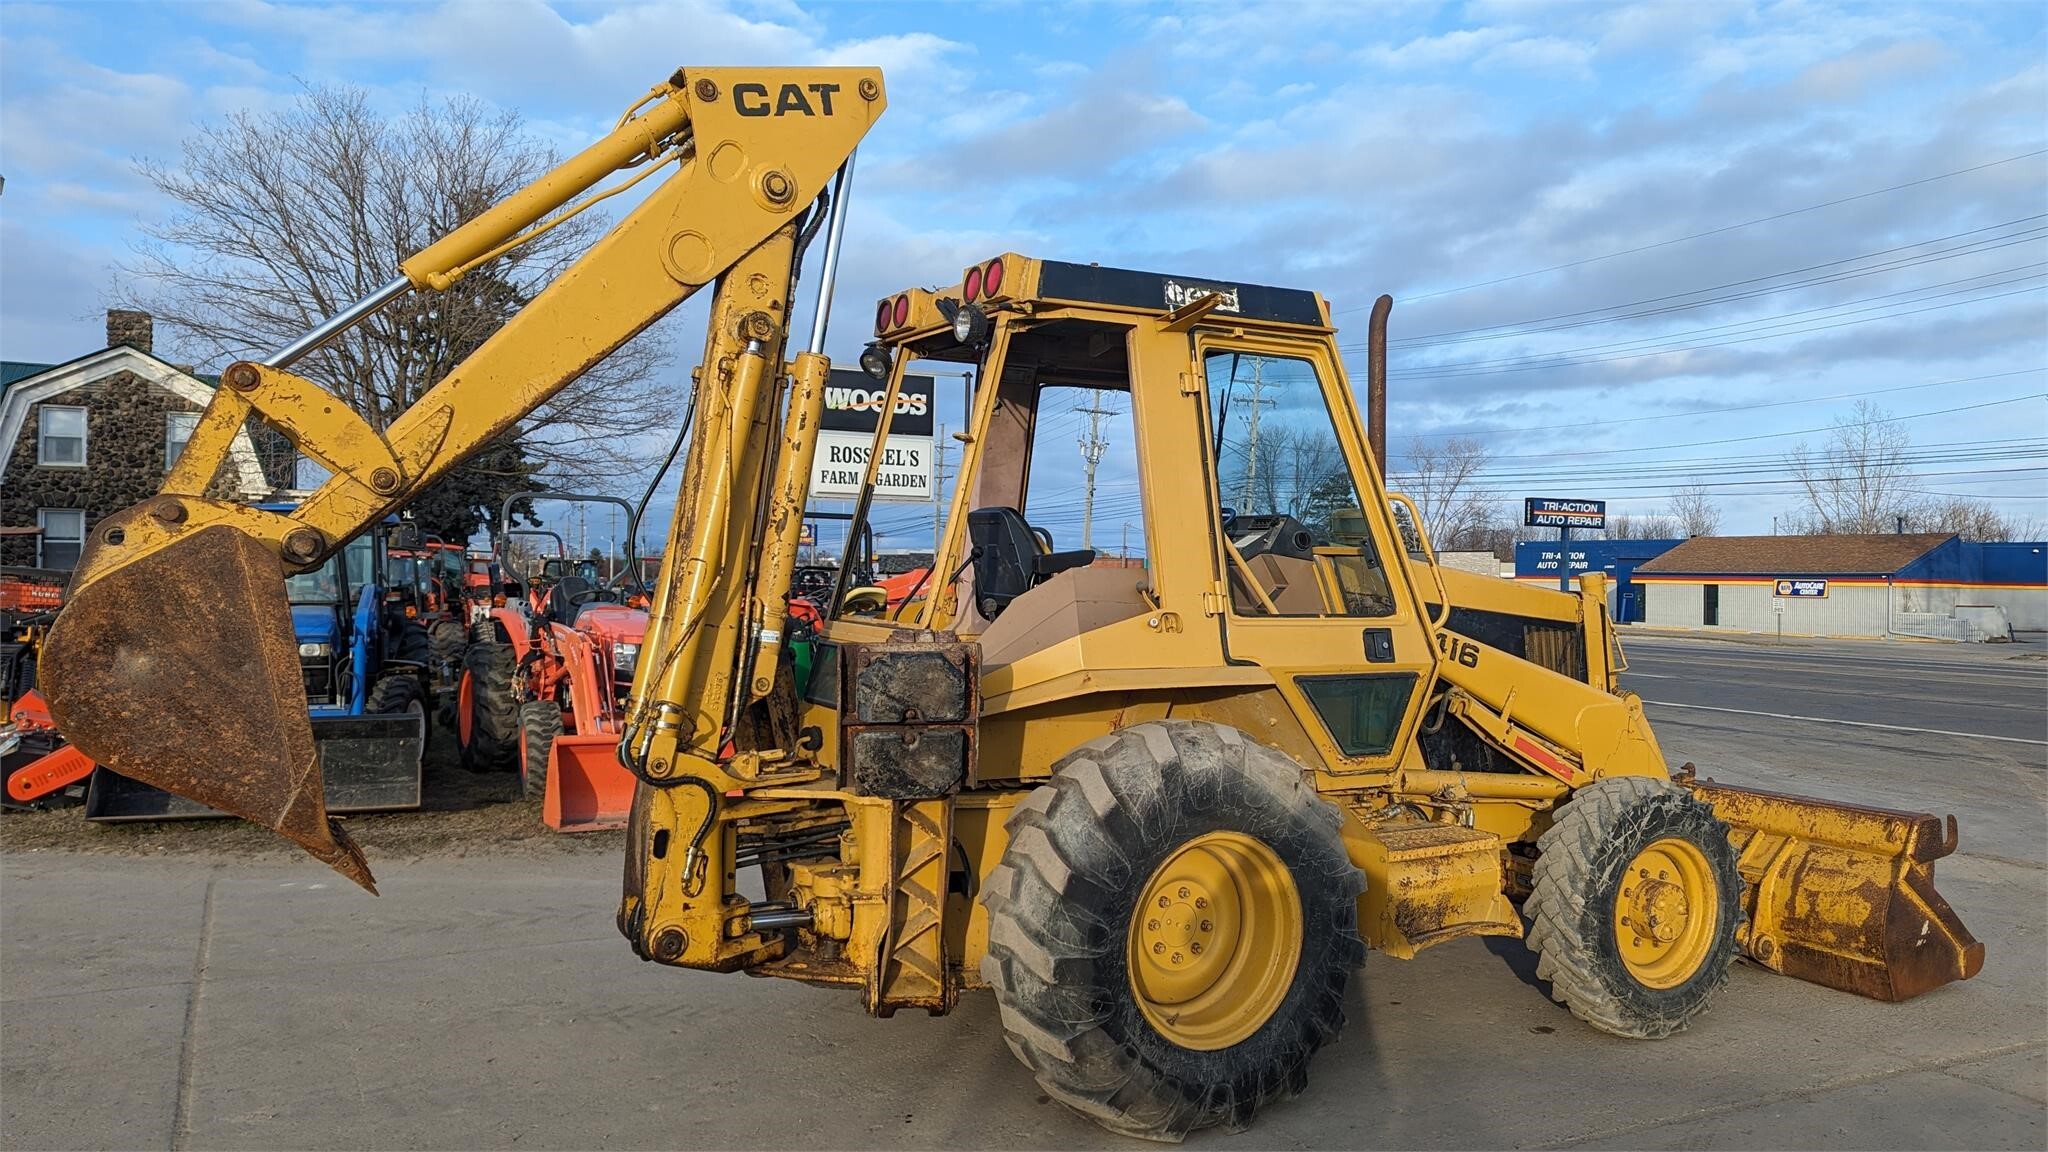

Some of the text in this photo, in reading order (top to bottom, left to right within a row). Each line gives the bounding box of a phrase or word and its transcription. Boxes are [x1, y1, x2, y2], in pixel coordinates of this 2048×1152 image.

[733, 83, 840, 116] CAT
[825, 387, 927, 416] WOODS
[830, 446, 919, 467] ROSSEL'S
[821, 470, 927, 488] FARM GARDEN
[1543, 501, 1598, 512] TRI-ACTION
[1537, 515, 1602, 526] AUTO REPAIR
[1541, 552, 1586, 560] TRI-AION
[1537, 561, 1558, 569] AUTO
